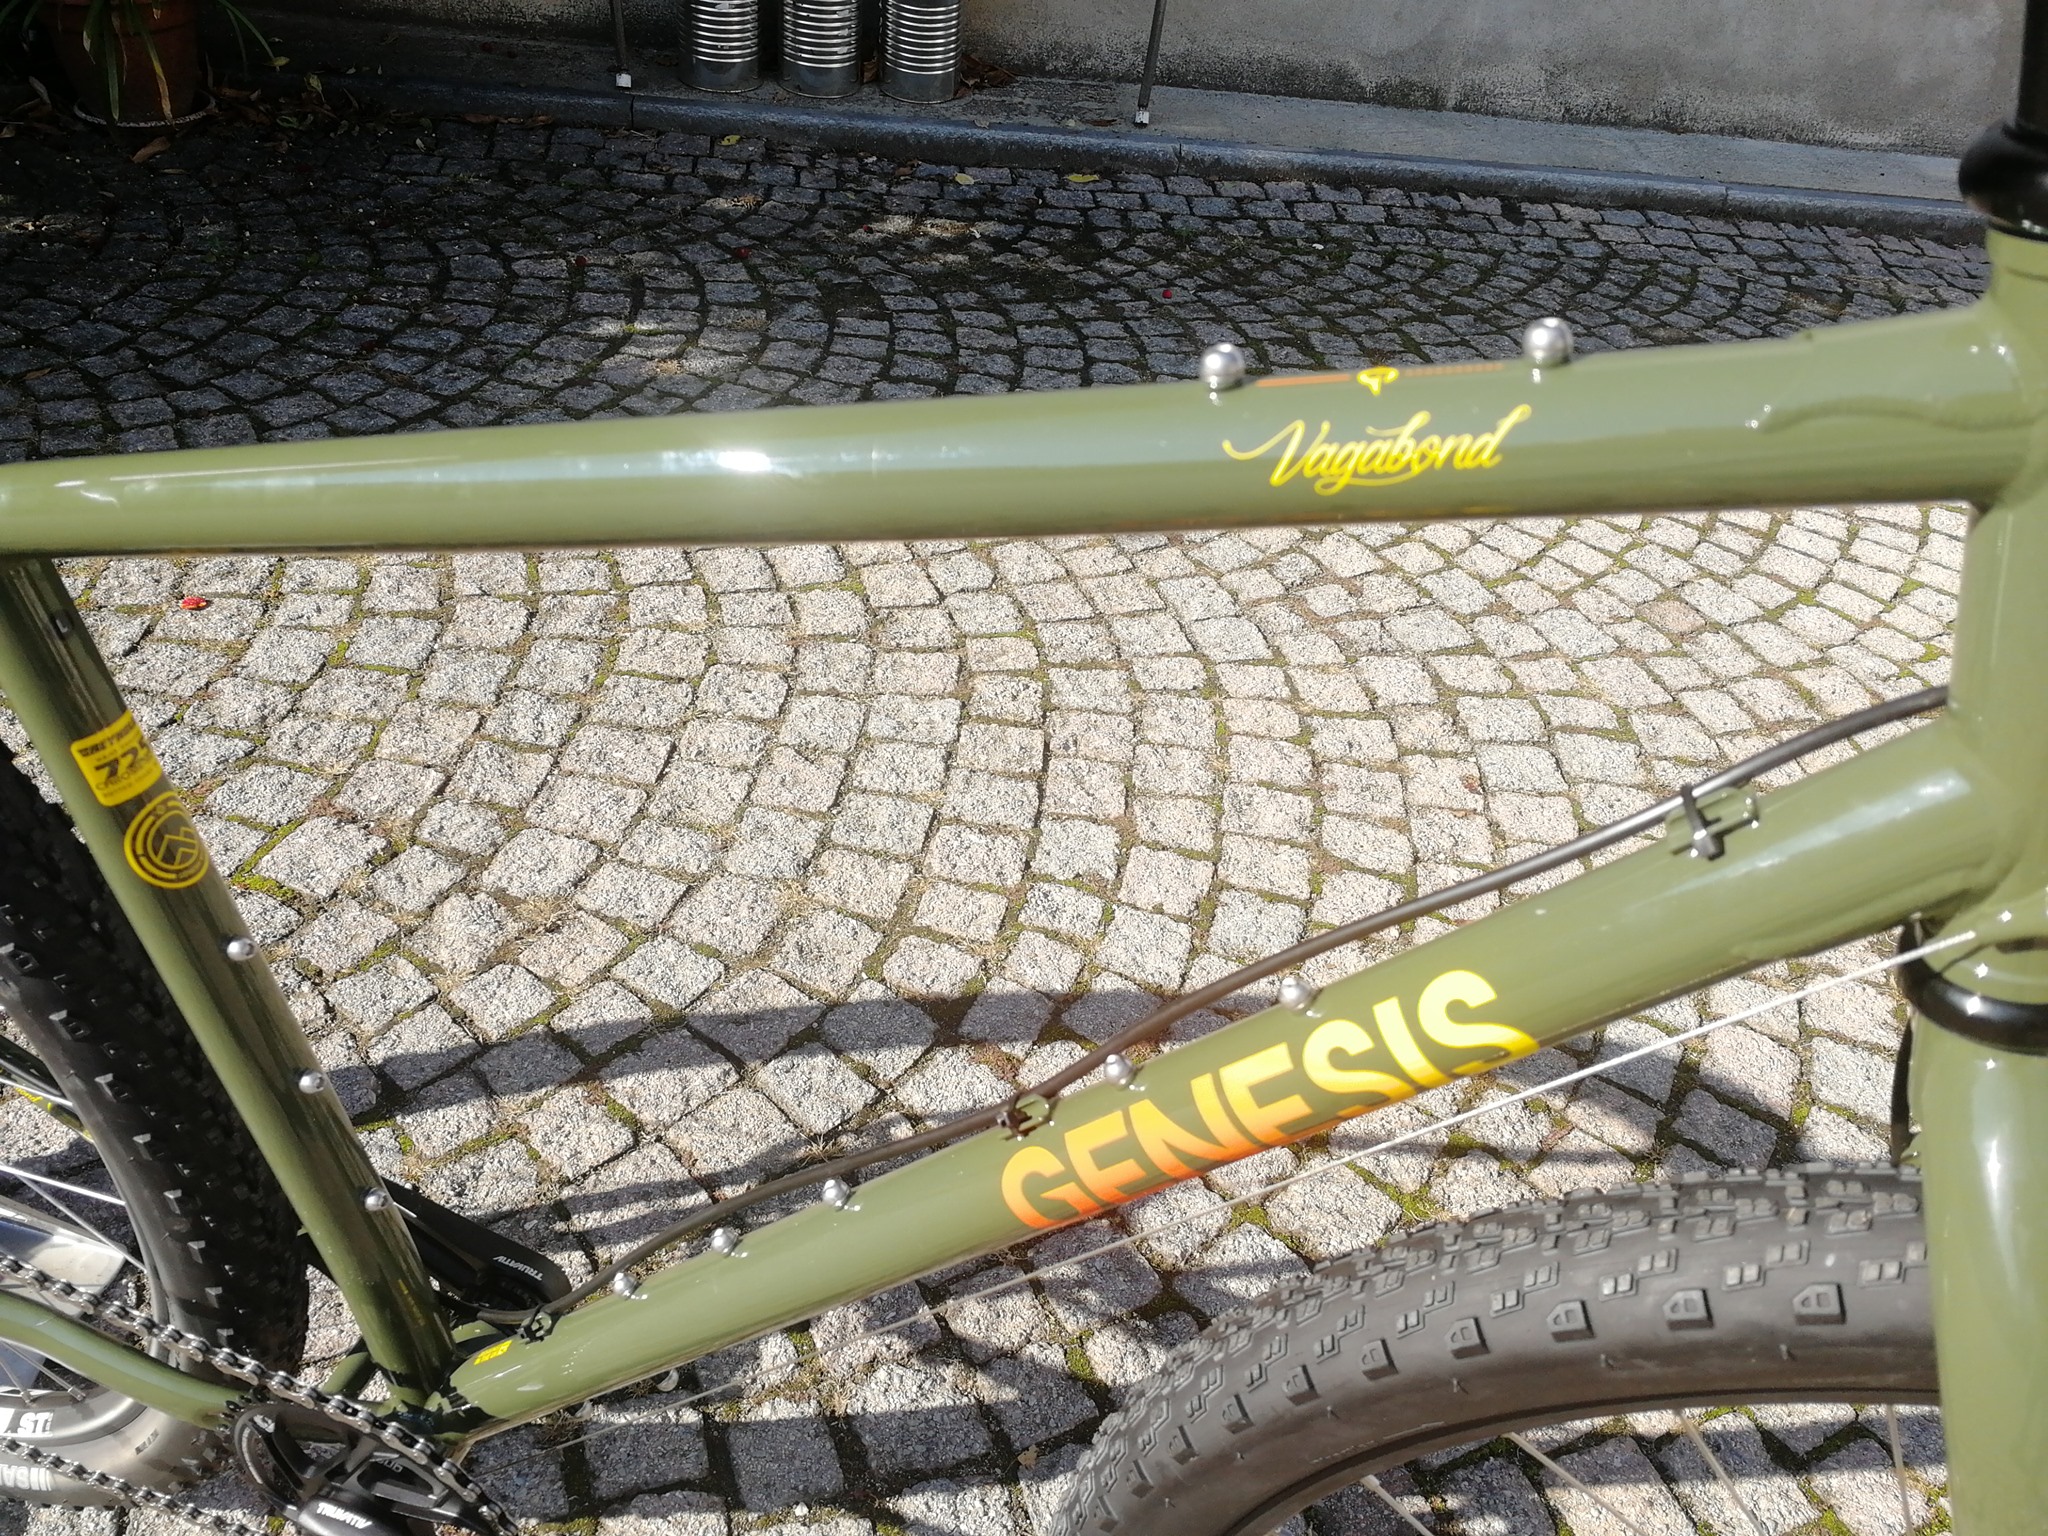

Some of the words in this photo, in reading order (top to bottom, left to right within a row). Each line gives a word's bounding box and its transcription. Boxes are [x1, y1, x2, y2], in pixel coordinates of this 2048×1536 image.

[1222, 403, 1532, 495] Vagabond
[1001, 969, 1539, 1229] GENESIS
[493, 1254, 544, 1282] TRUVATIV
[316, 1502, 373, 1530] TRUVATIV
